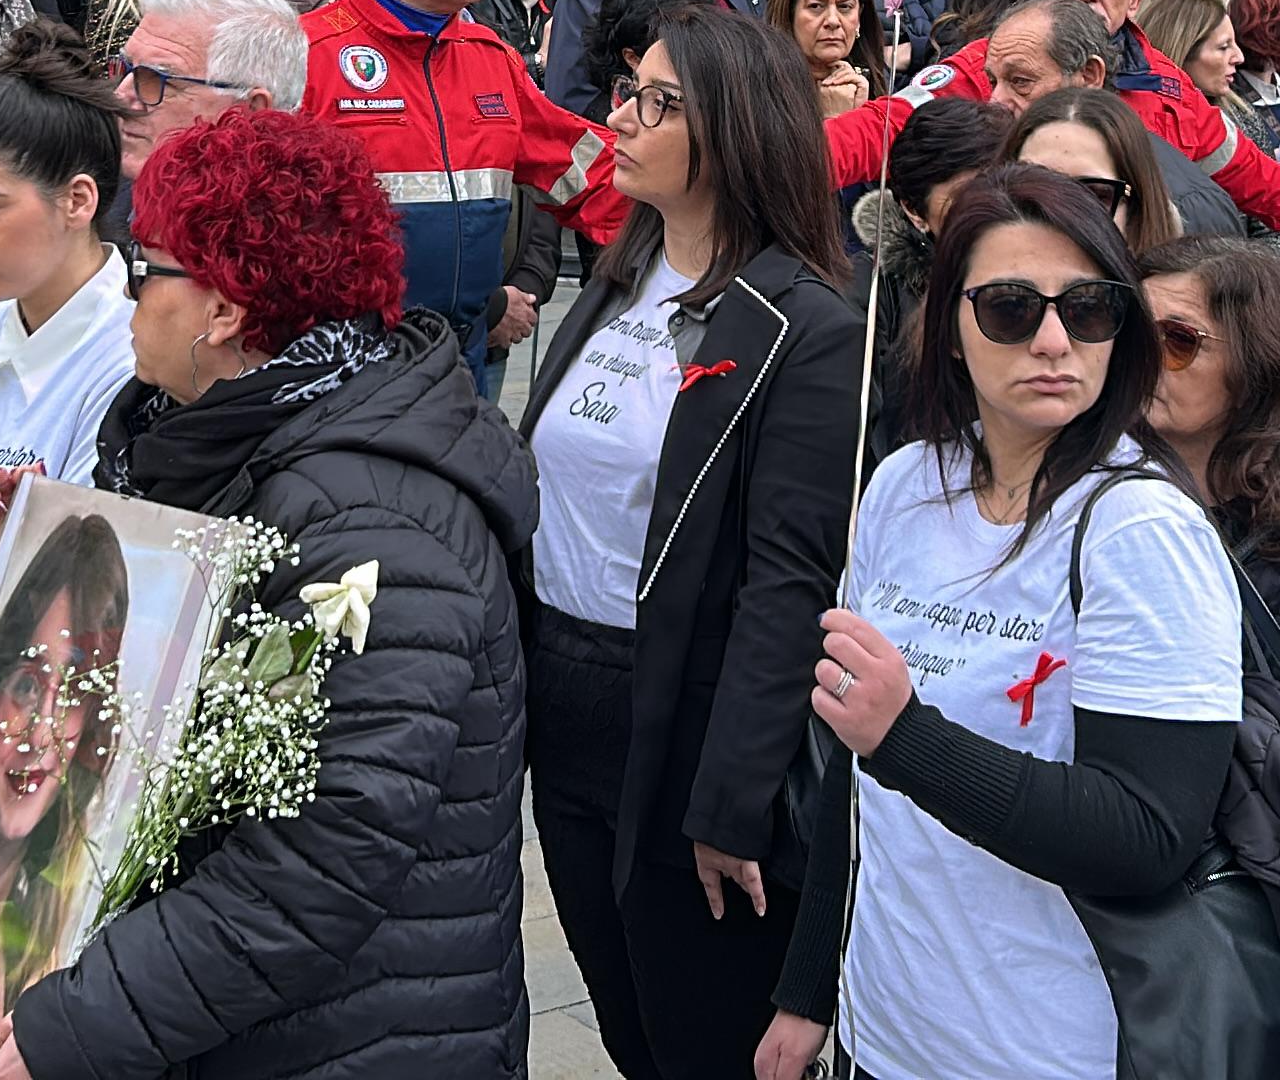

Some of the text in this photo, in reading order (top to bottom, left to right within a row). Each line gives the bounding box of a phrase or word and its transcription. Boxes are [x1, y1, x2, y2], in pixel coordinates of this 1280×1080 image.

[570, 382, 621, 424] Sara
[961, 610, 997, 637] per
[999, 613, 1044, 642] stare
